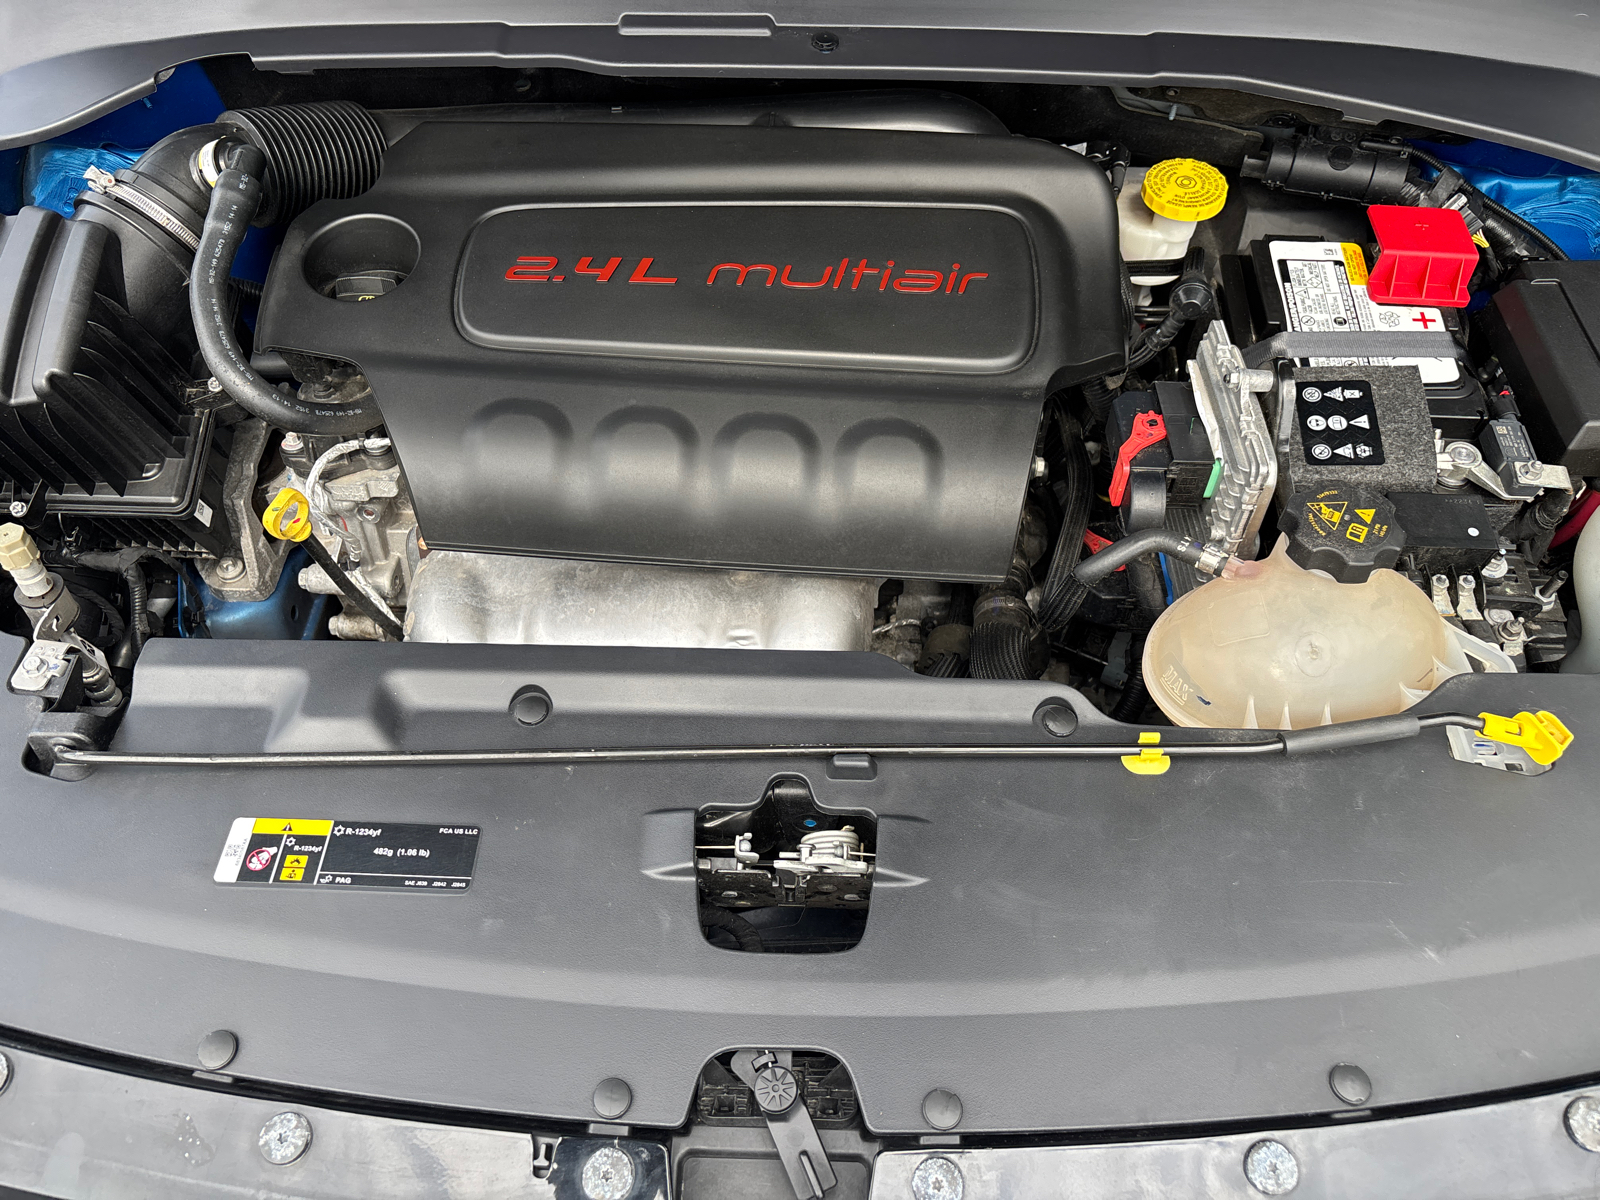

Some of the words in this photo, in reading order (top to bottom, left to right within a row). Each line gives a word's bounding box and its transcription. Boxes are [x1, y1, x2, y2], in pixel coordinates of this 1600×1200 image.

[706, 257, 989, 295] multiair
[345, 828, 382, 838] R-1234yf
[293, 845, 323, 853] R-1234yf
[373, 847, 393, 857] 482g
